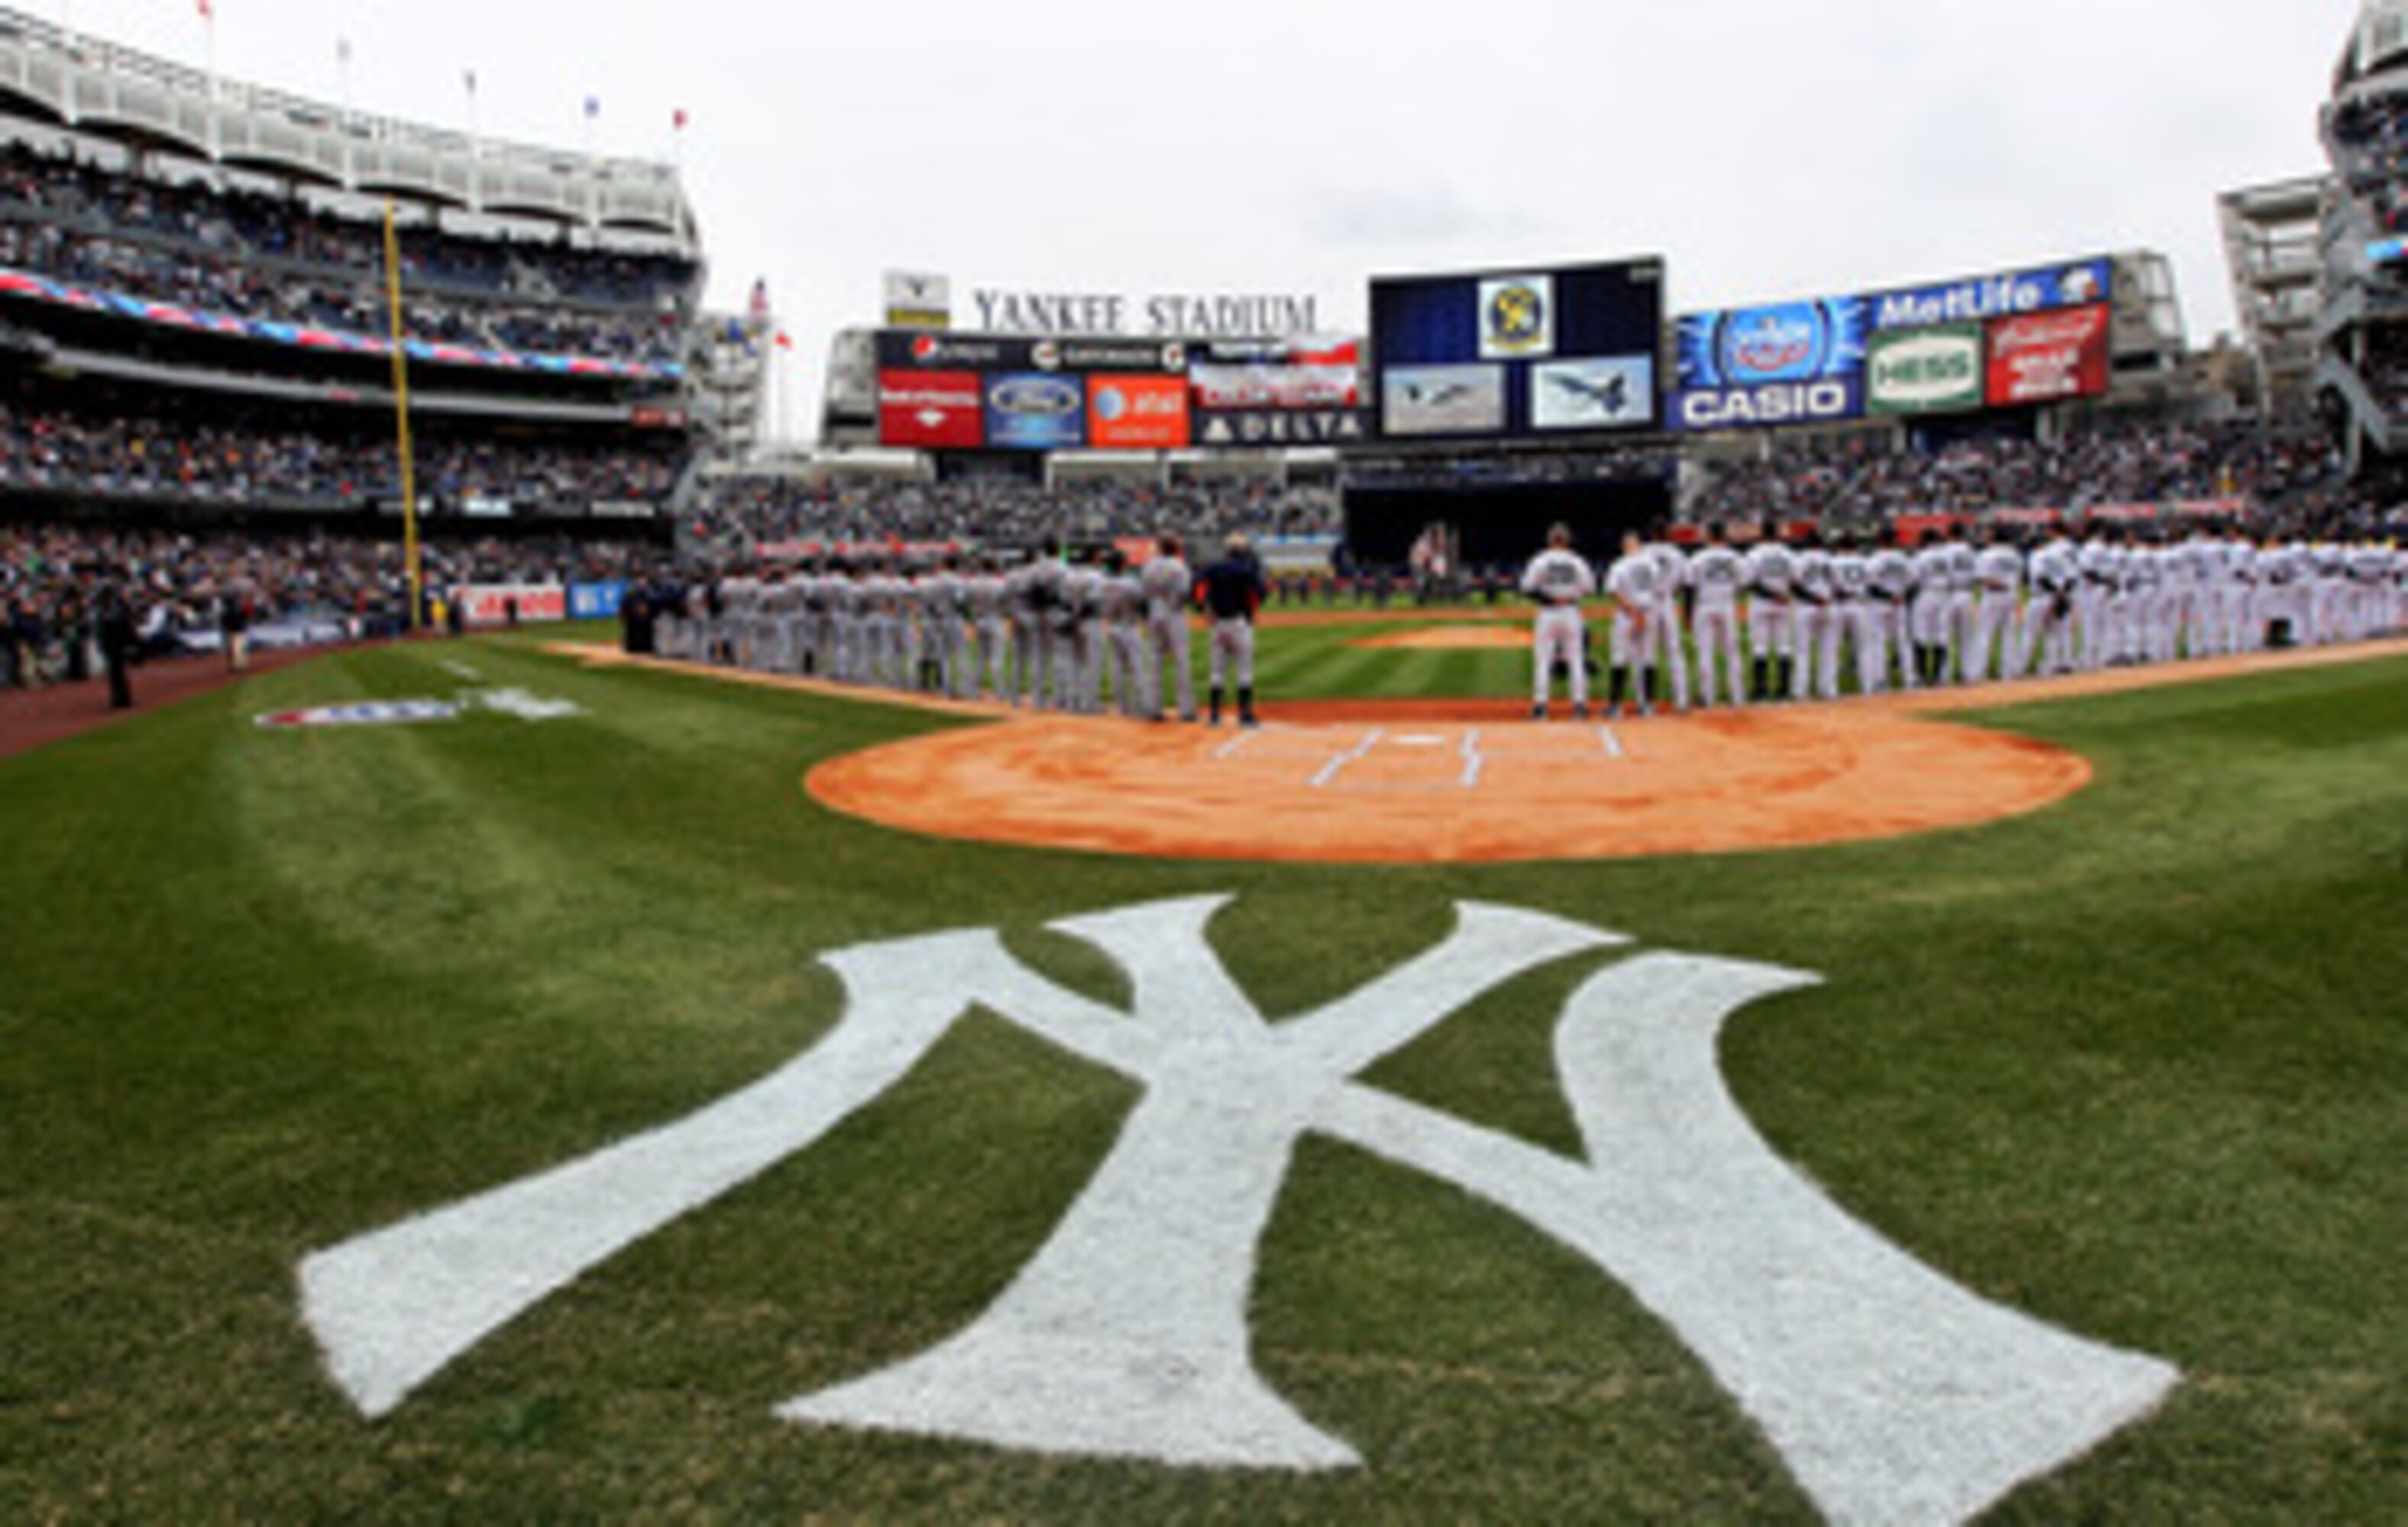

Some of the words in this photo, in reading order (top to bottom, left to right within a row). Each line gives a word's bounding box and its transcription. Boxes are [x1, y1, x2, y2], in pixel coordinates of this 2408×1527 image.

[972, 288, 1124, 331] YANKEE
[1145, 293, 1317, 334] STADIUM
[1877, 276, 2042, 328] MetLife
[1876, 350, 1973, 385] HESS
[1240, 410, 1362, 441] DELTA
[1683, 382, 1846, 425] CASIO
[296, 890, 2183, 1527] NY
